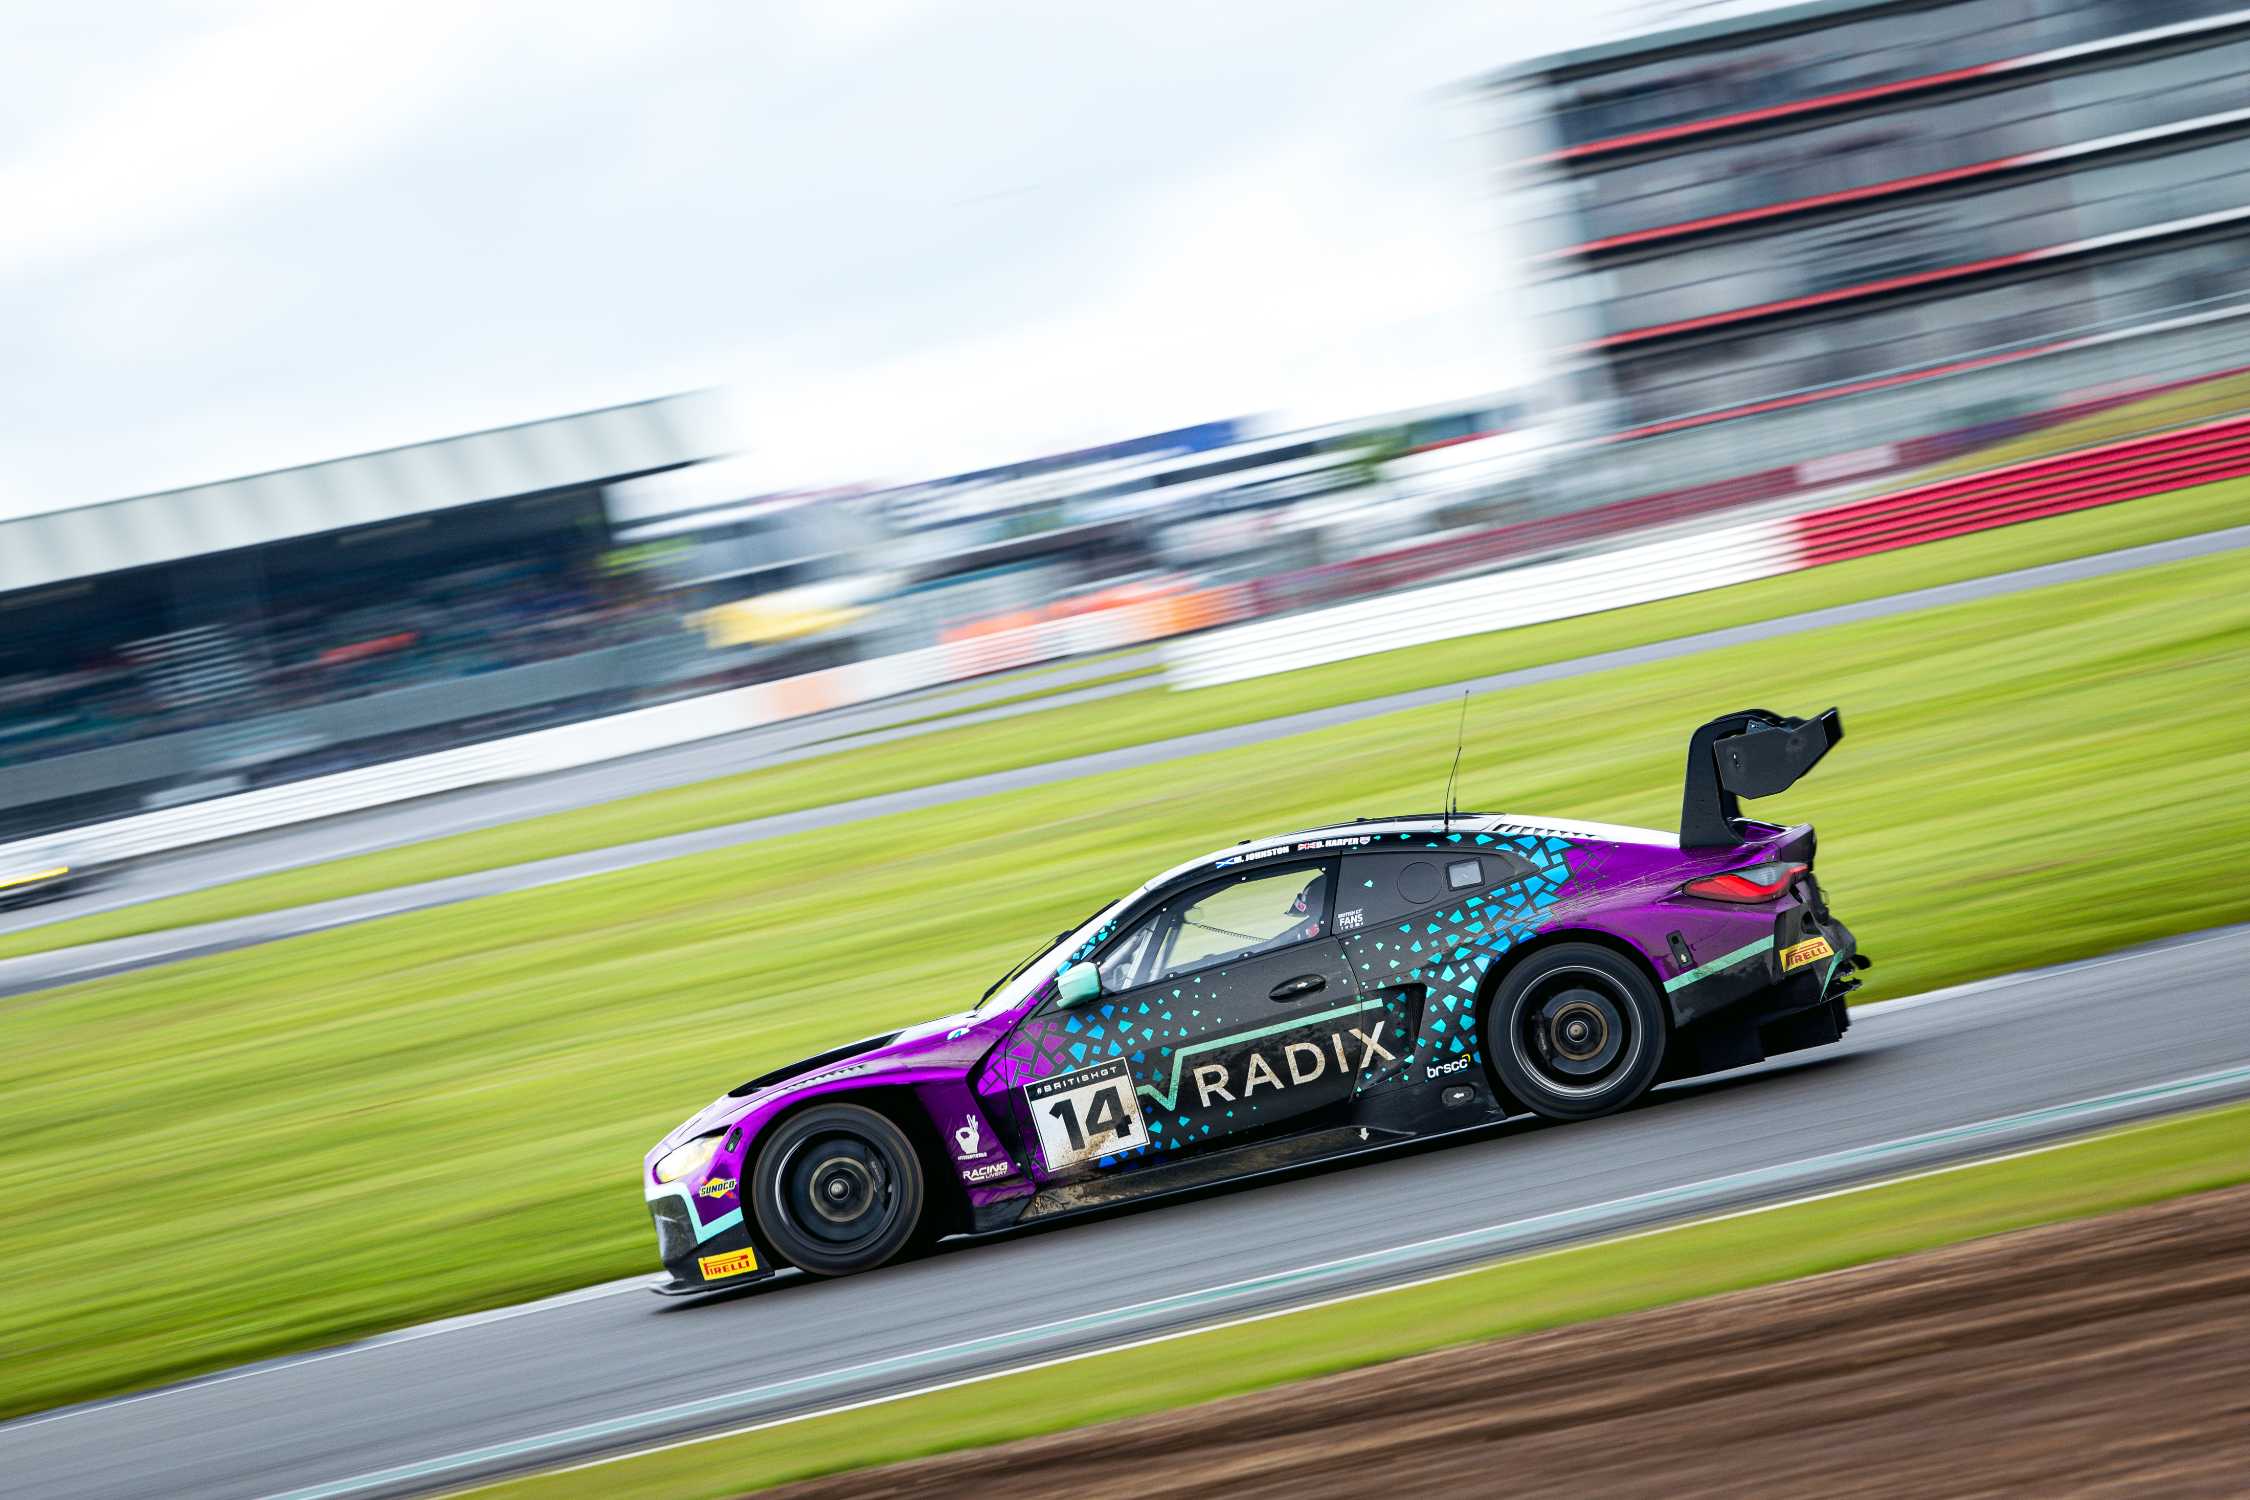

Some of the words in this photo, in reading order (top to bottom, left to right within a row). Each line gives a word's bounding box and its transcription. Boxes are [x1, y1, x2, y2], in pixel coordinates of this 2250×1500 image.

[1326, 837, 1359, 848] HARPER
[1245, 846, 1290, 864] JOHNSTON
[1339, 913, 1363, 927] FANS
[1785, 941, 1829, 967] PIRELLI
[1192, 1020, 1397, 1108] RADIX
[1426, 1058, 1469, 1079] brscc
[1036, 1066, 1118, 1095] #BRITISHGT
[1048, 1085, 1133, 1152] 14
[962, 1161, 1008, 1181] RACING
[700, 1180, 736, 1196] SUNOCO
[703, 1254, 750, 1276] PIRELLI
